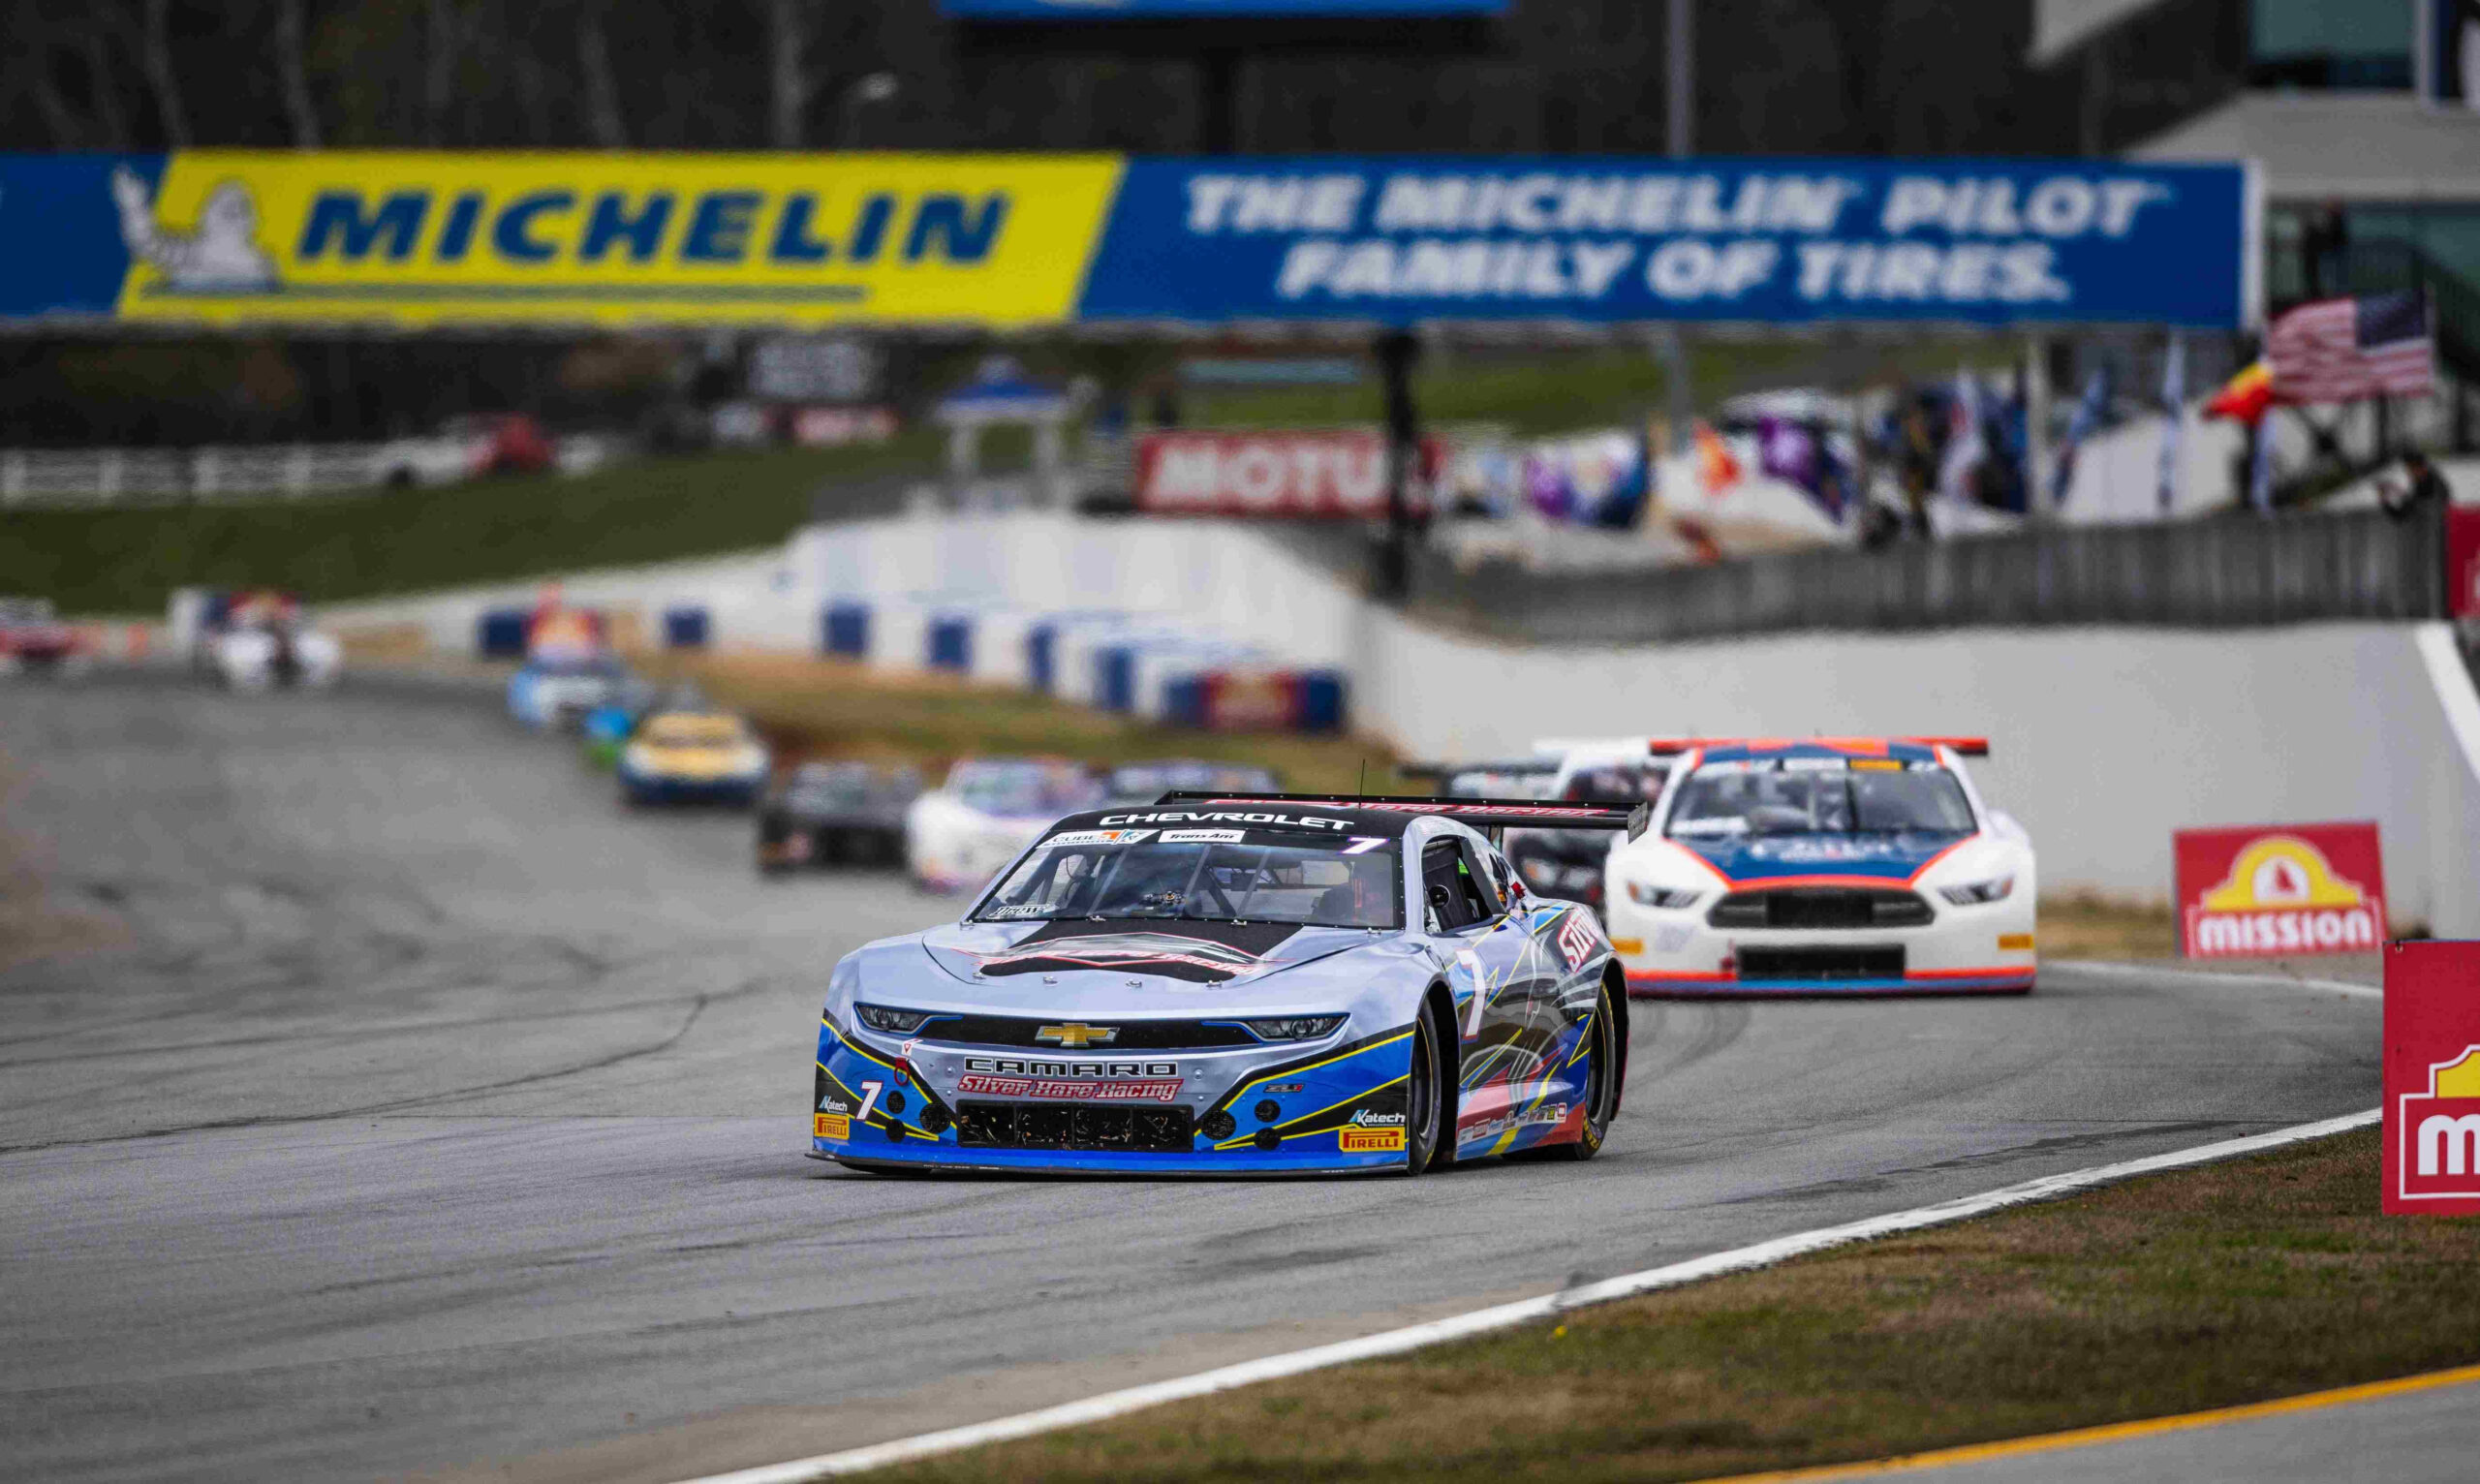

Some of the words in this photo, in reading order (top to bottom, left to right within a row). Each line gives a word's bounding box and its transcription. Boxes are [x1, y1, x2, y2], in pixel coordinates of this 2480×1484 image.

[1185, 172, 1364, 233] THE
[1372, 173, 1848, 234] MICHELIN
[1883, 174, 2153, 238] PILOT
[295, 187, 1011, 266] MICHELIN
[1275, 237, 1635, 300] FAMILY
[1645, 238, 1782, 300] OF
[1150, 442, 1432, 506] MOTU
[1099, 812, 1355, 831] CHEVROLET
[1339, 837, 1391, 855] 7
[1454, 946, 1486, 1043] 7
[964, 1056, 1179, 1077] CAMARO
[958, 1073, 1033, 1097] Silver
[1031, 1079, 1100, 1098] Hare
[1096, 1078, 1184, 1102] Racing
[821, 1095, 848, 1113] Katech
[856, 1080, 884, 1121] 7
[817, 1116, 848, 1136] PIRELLI
[1353, 1109, 1406, 1127] Katech
[1342, 1130, 1400, 1149] PIRELLI
